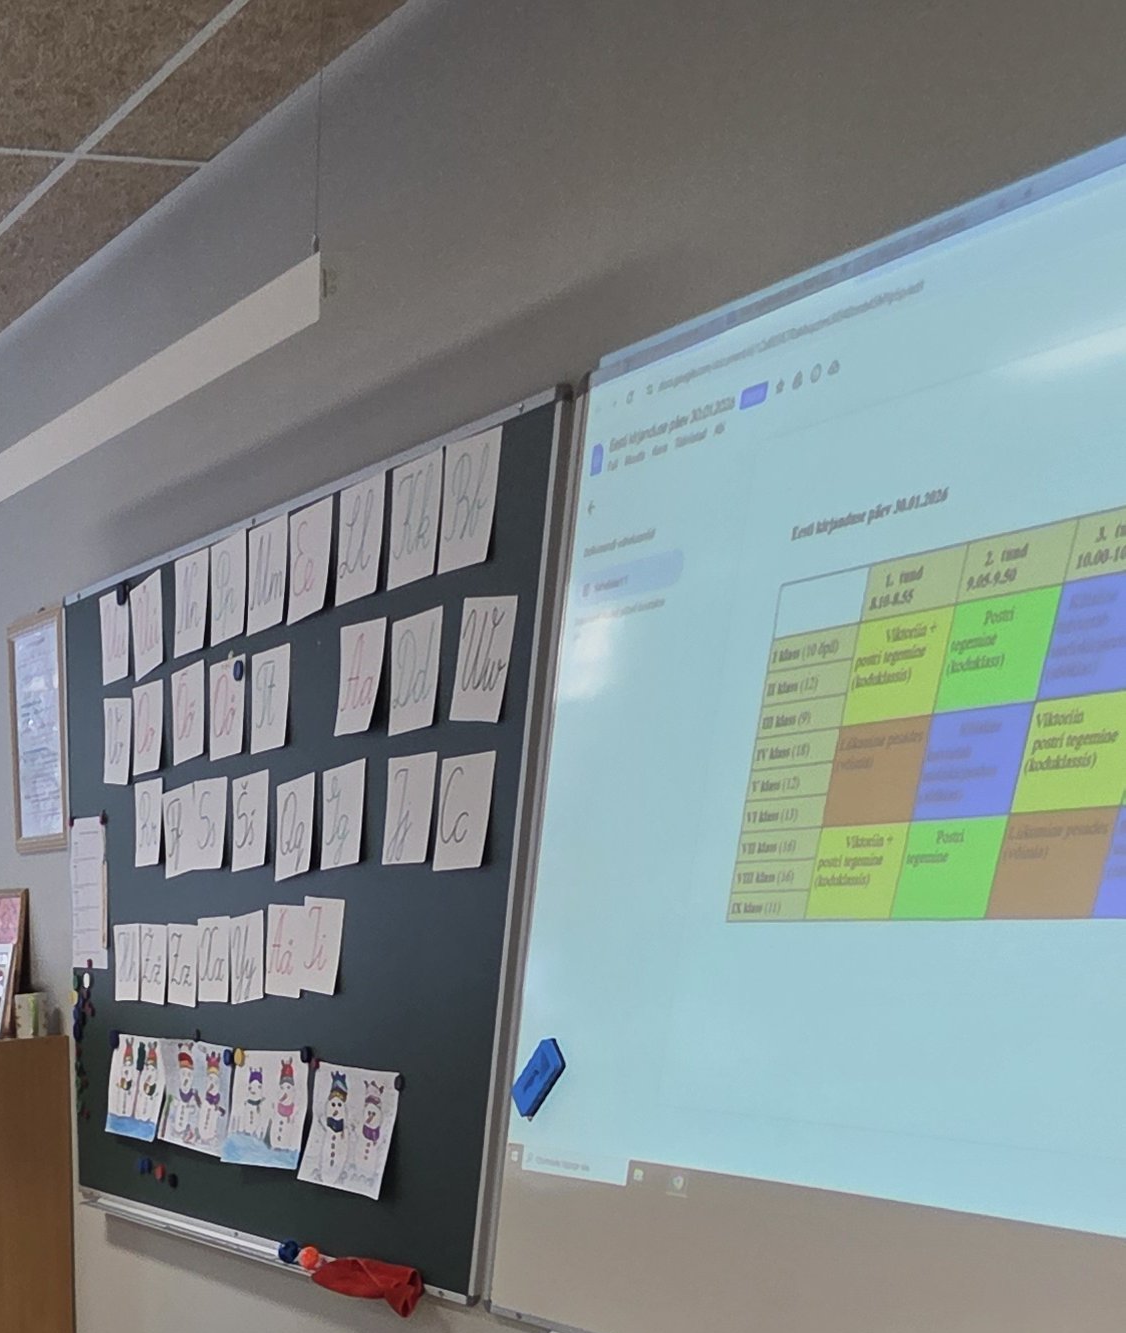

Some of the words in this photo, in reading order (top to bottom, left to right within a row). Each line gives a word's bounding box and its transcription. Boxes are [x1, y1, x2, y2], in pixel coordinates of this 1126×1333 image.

[293, 521, 316, 597] Ee
[791, 522, 815, 541] Eesti
[867, 503, 892, 525] päev
[1001, 543, 1029, 562] tund
[249, 532, 283, 611] Mm
[899, 566, 924, 584] tund
[340, 632, 374, 712] Aa
[393, 621, 436, 709] Dd
[441, 766, 469, 844] Cc
